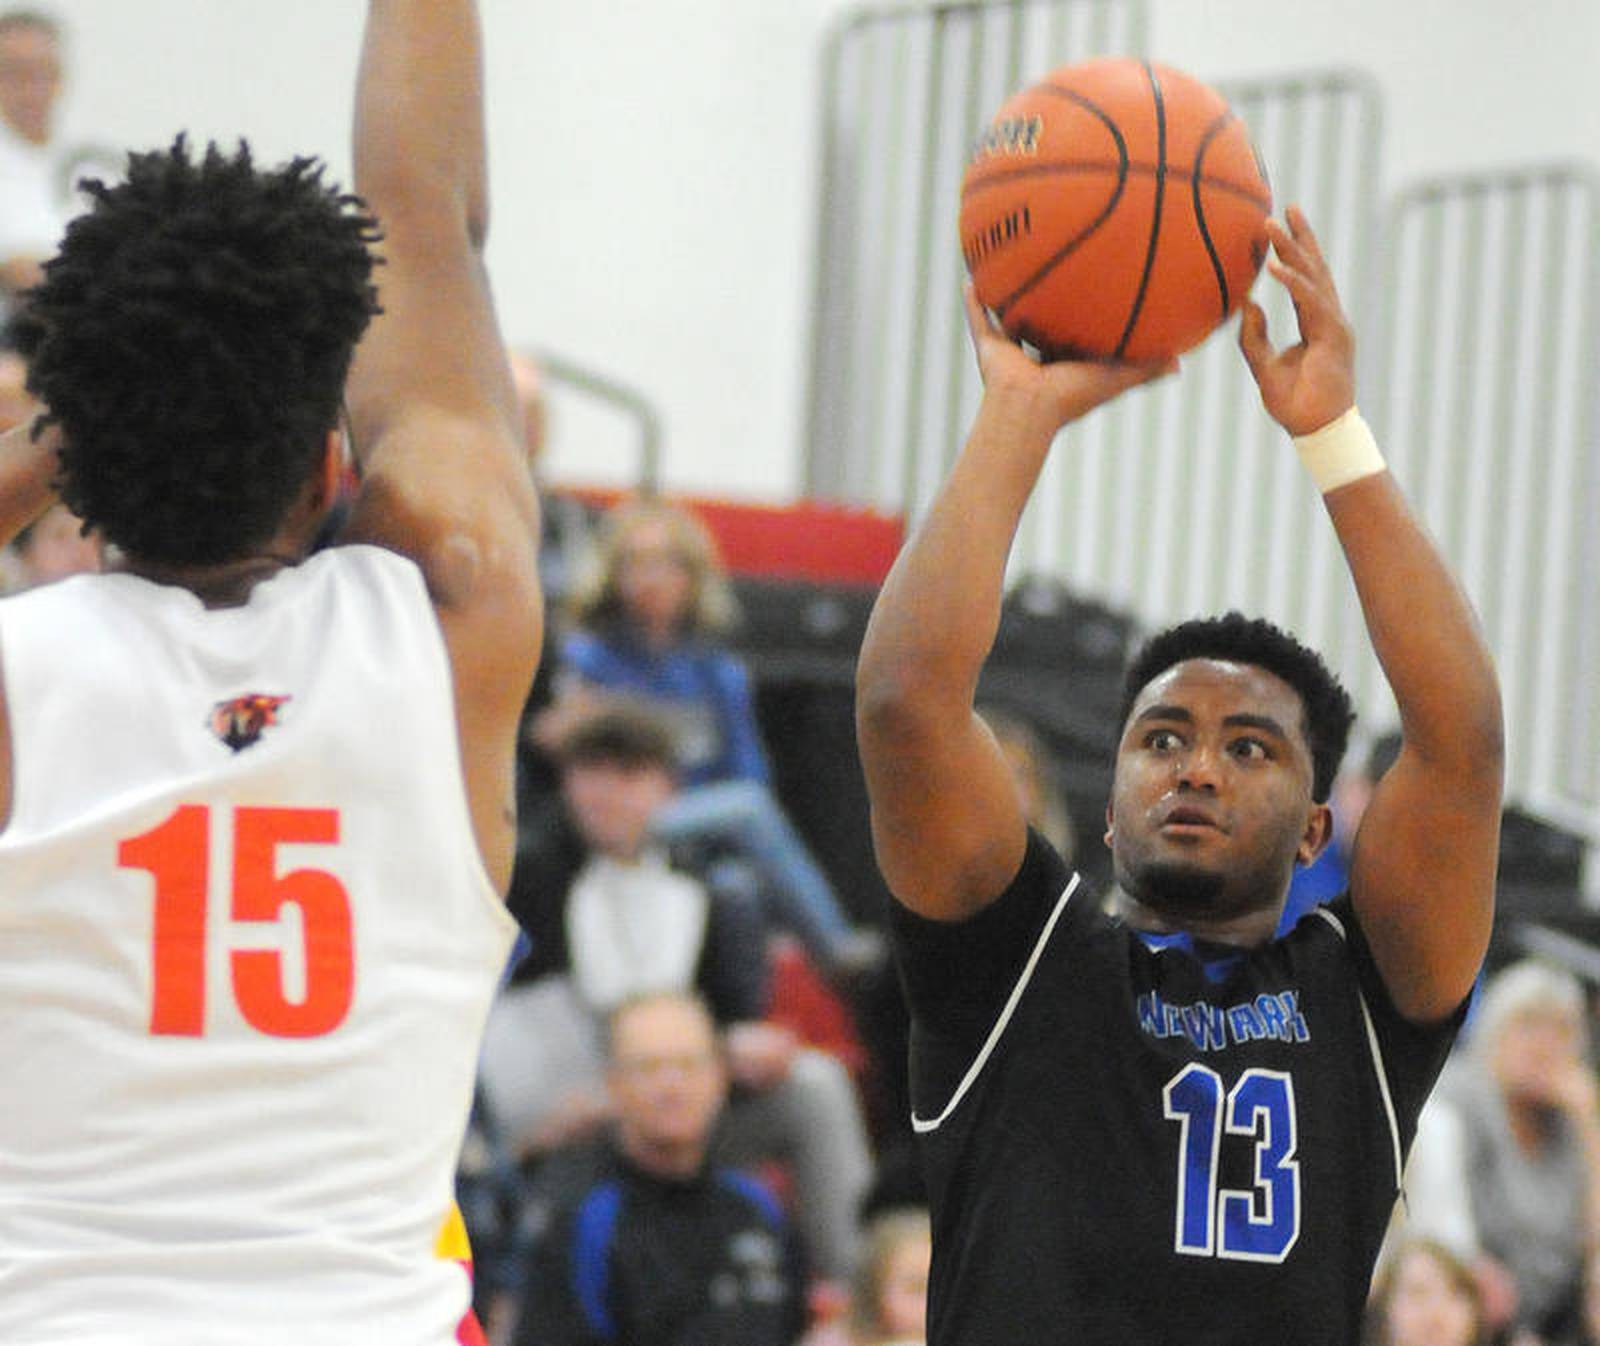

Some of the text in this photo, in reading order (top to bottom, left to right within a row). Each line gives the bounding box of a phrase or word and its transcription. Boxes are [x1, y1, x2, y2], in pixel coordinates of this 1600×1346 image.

[117, 804, 355, 1040] 15
[1137, 989, 1311, 1051] NEWARK
[1162, 1062, 1302, 1264] 13
